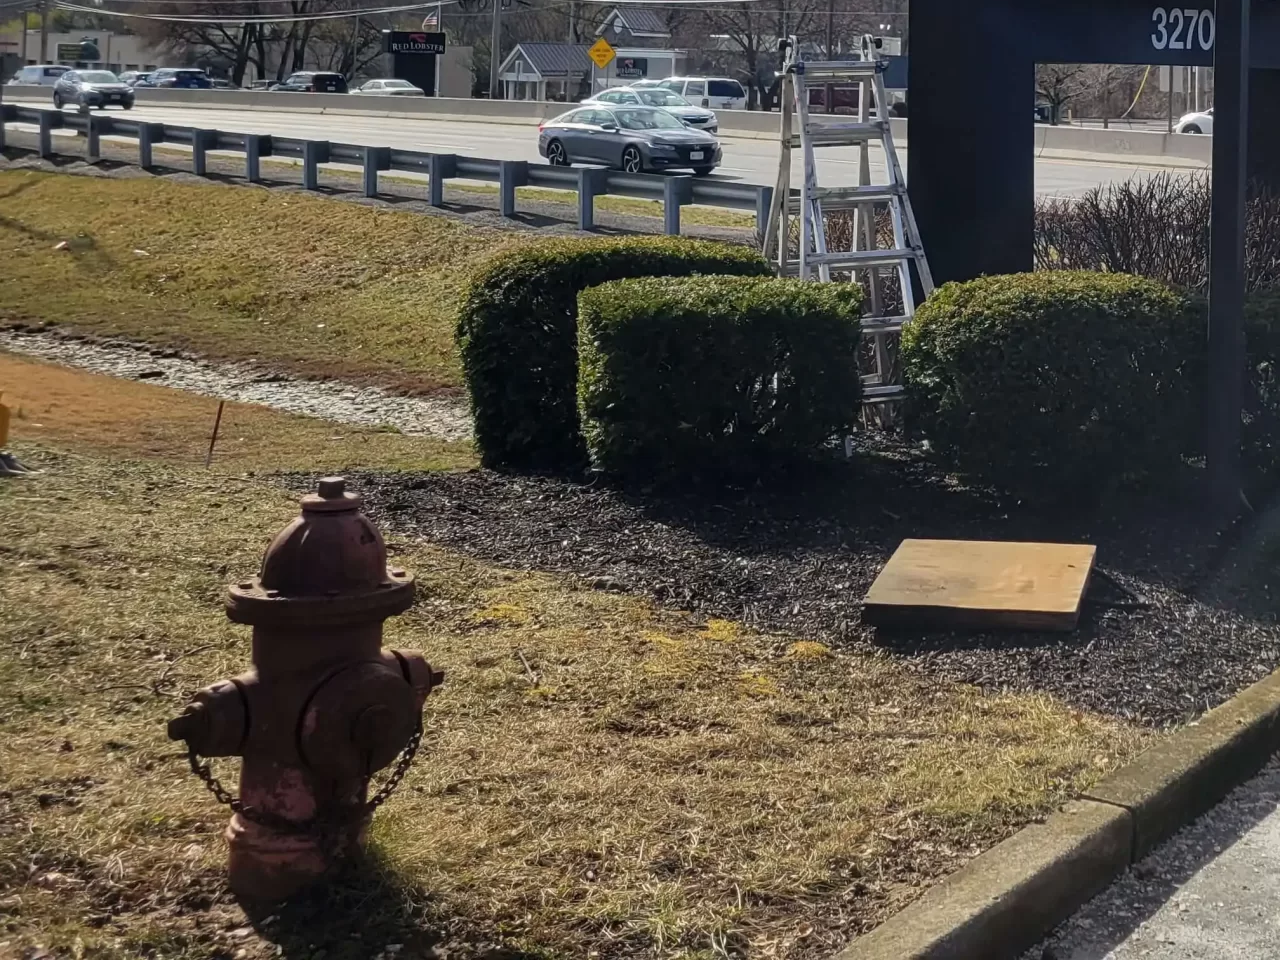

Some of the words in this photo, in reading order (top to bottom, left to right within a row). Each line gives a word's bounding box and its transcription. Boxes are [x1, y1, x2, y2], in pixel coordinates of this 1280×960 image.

[1151, 6, 1216, 51] 3270
[392, 42, 409, 51] RED
[410, 41, 444, 52] LOBSTER
